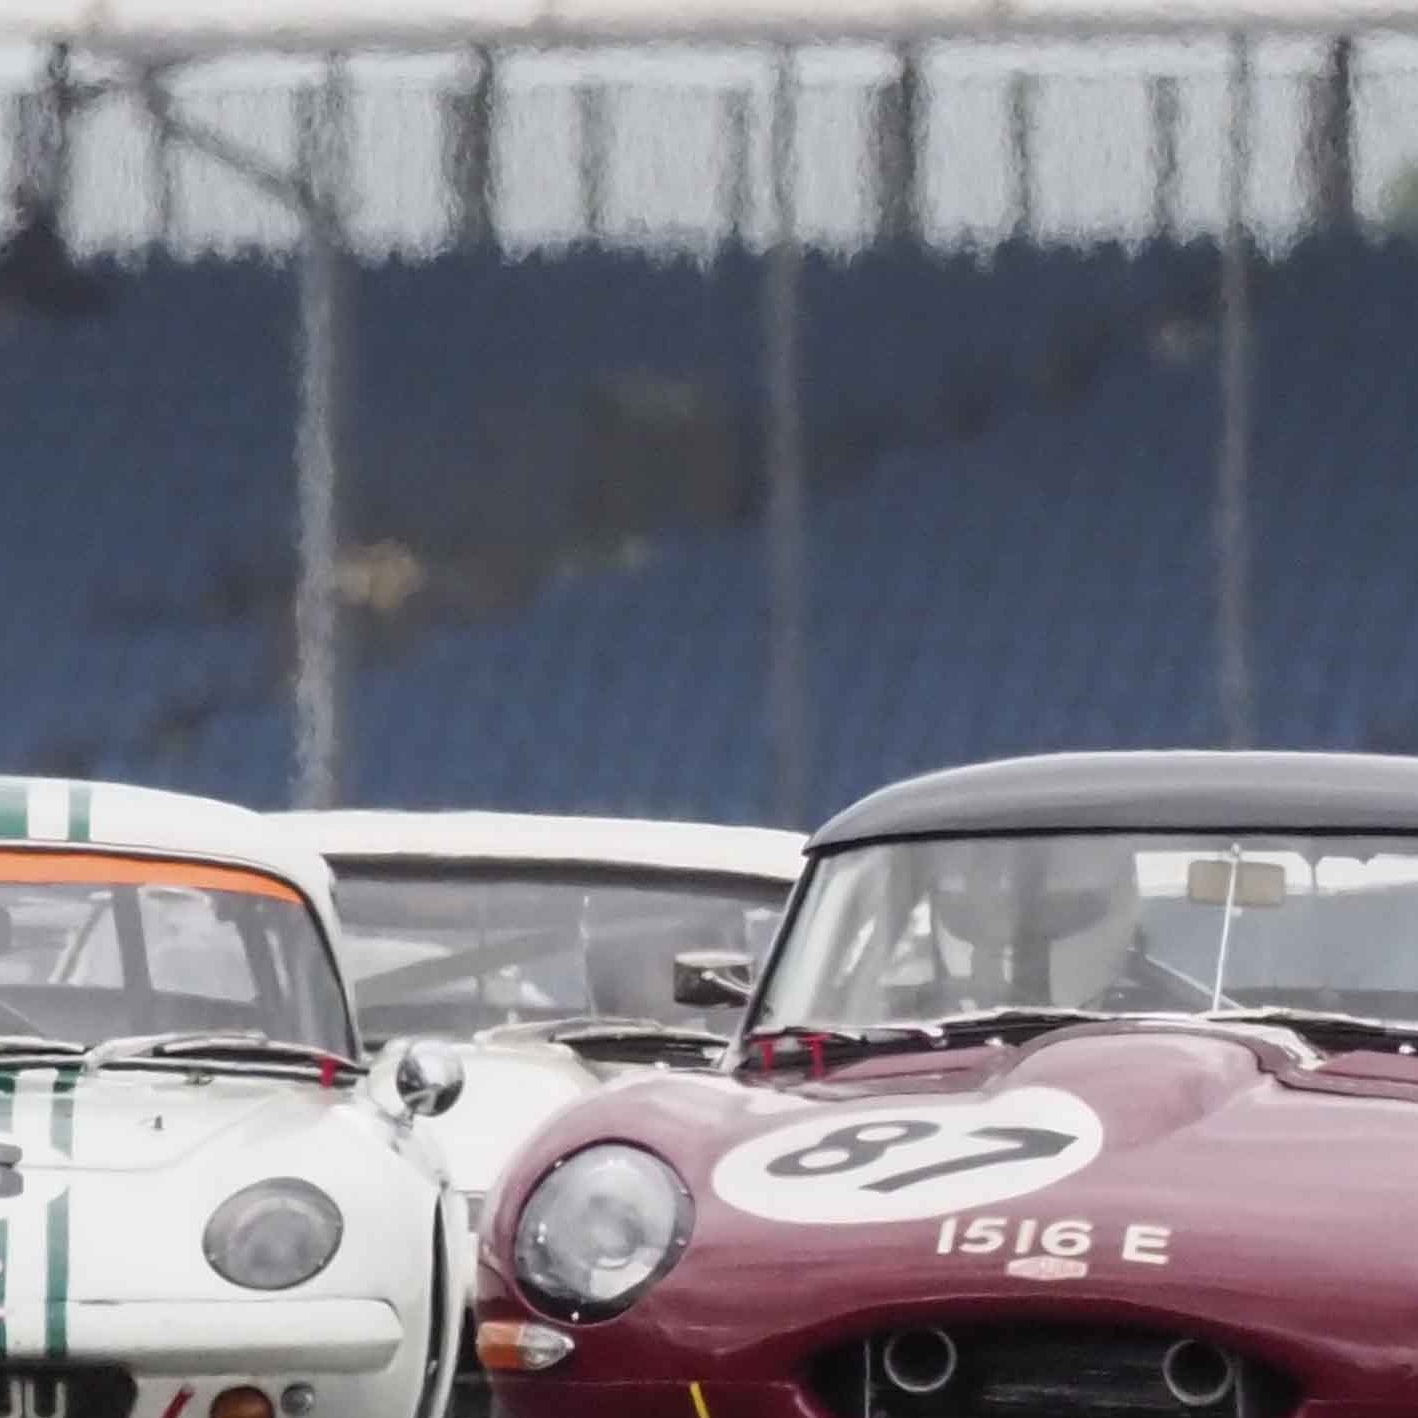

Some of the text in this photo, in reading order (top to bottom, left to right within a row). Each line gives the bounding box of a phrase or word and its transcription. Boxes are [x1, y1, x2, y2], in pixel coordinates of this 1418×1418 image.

[765, 1119, 1080, 1194] 87
[935, 1216, 1172, 1265] 1516 E
